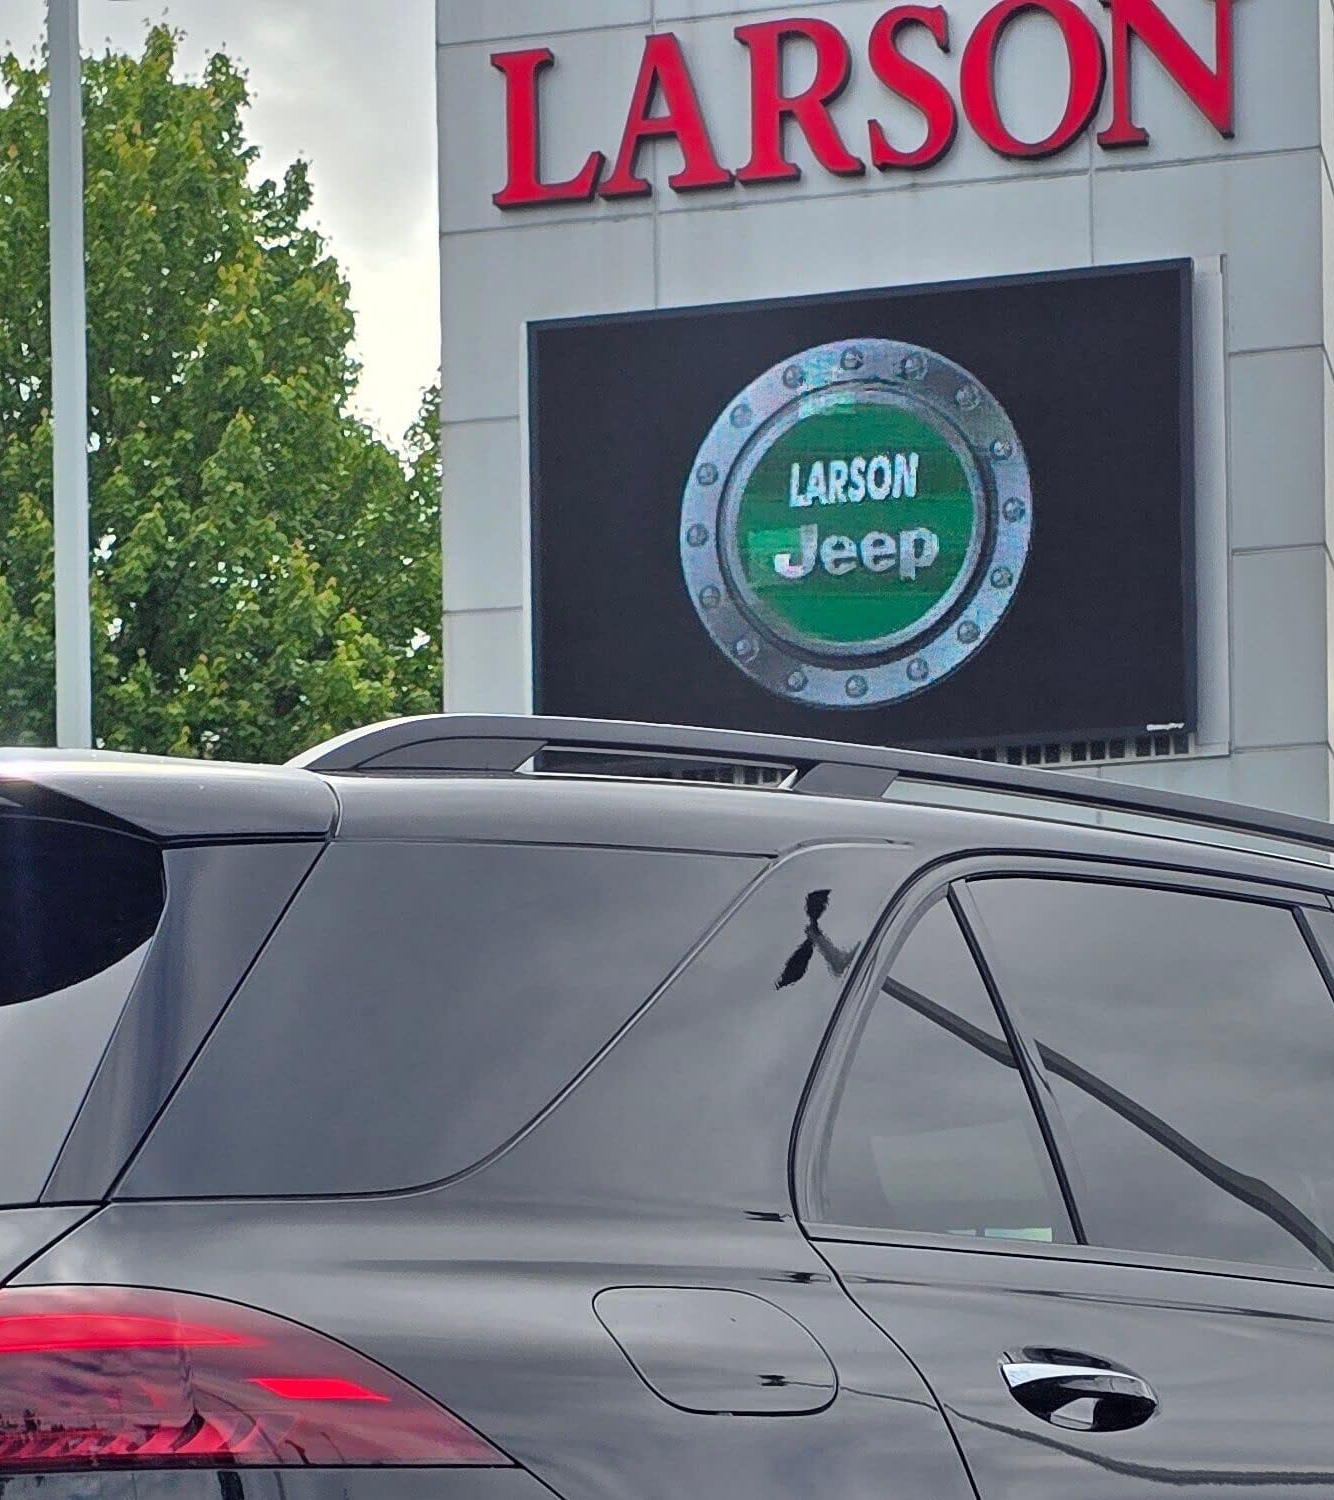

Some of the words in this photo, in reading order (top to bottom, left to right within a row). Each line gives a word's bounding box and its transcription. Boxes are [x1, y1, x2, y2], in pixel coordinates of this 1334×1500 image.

[491, 0, 1235, 209] LARSON
[789, 452, 919, 507] LARSON
[774, 523, 940, 581] Jeep
